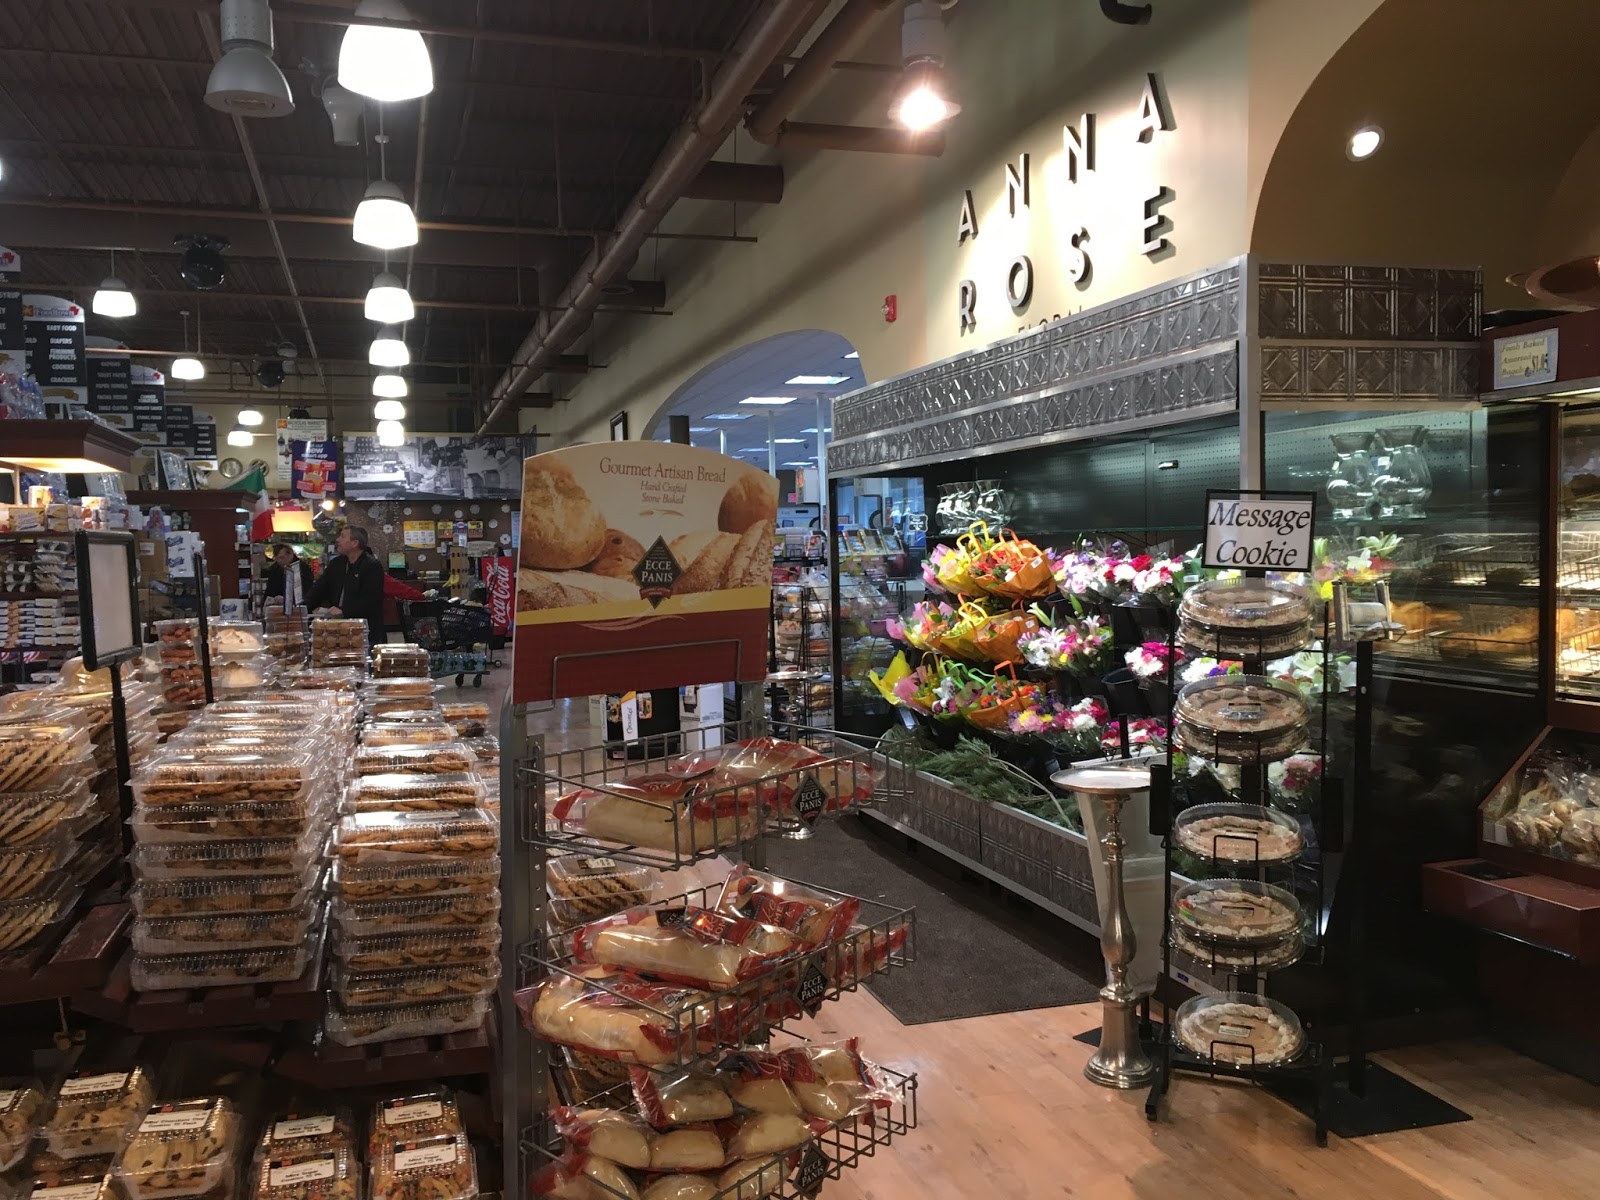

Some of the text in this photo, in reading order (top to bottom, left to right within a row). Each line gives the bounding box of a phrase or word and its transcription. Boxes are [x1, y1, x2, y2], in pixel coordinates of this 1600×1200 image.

[957, 72, 1172, 244] ANNA
[959, 186, 1172, 332] ROSE
[600, 457, 726, 482] Gourmet Artisan Bread
[640, 480, 687, 494] Hand Crafted
[641, 492, 685, 504] Stone Baked
[1209, 502, 1311, 536] Message
[1216, 540, 1298, 567] Cookie
[645, 560, 672, 570] ECCE
[641, 570, 673, 582] PANIS
[801, 790, 820, 801] ECCE
[799, 797, 822, 811] PANIS
[803, 975, 821, 990] ECCE
[801, 984, 824, 1000] PANIS
[803, 1158, 821, 1176] ECCE
